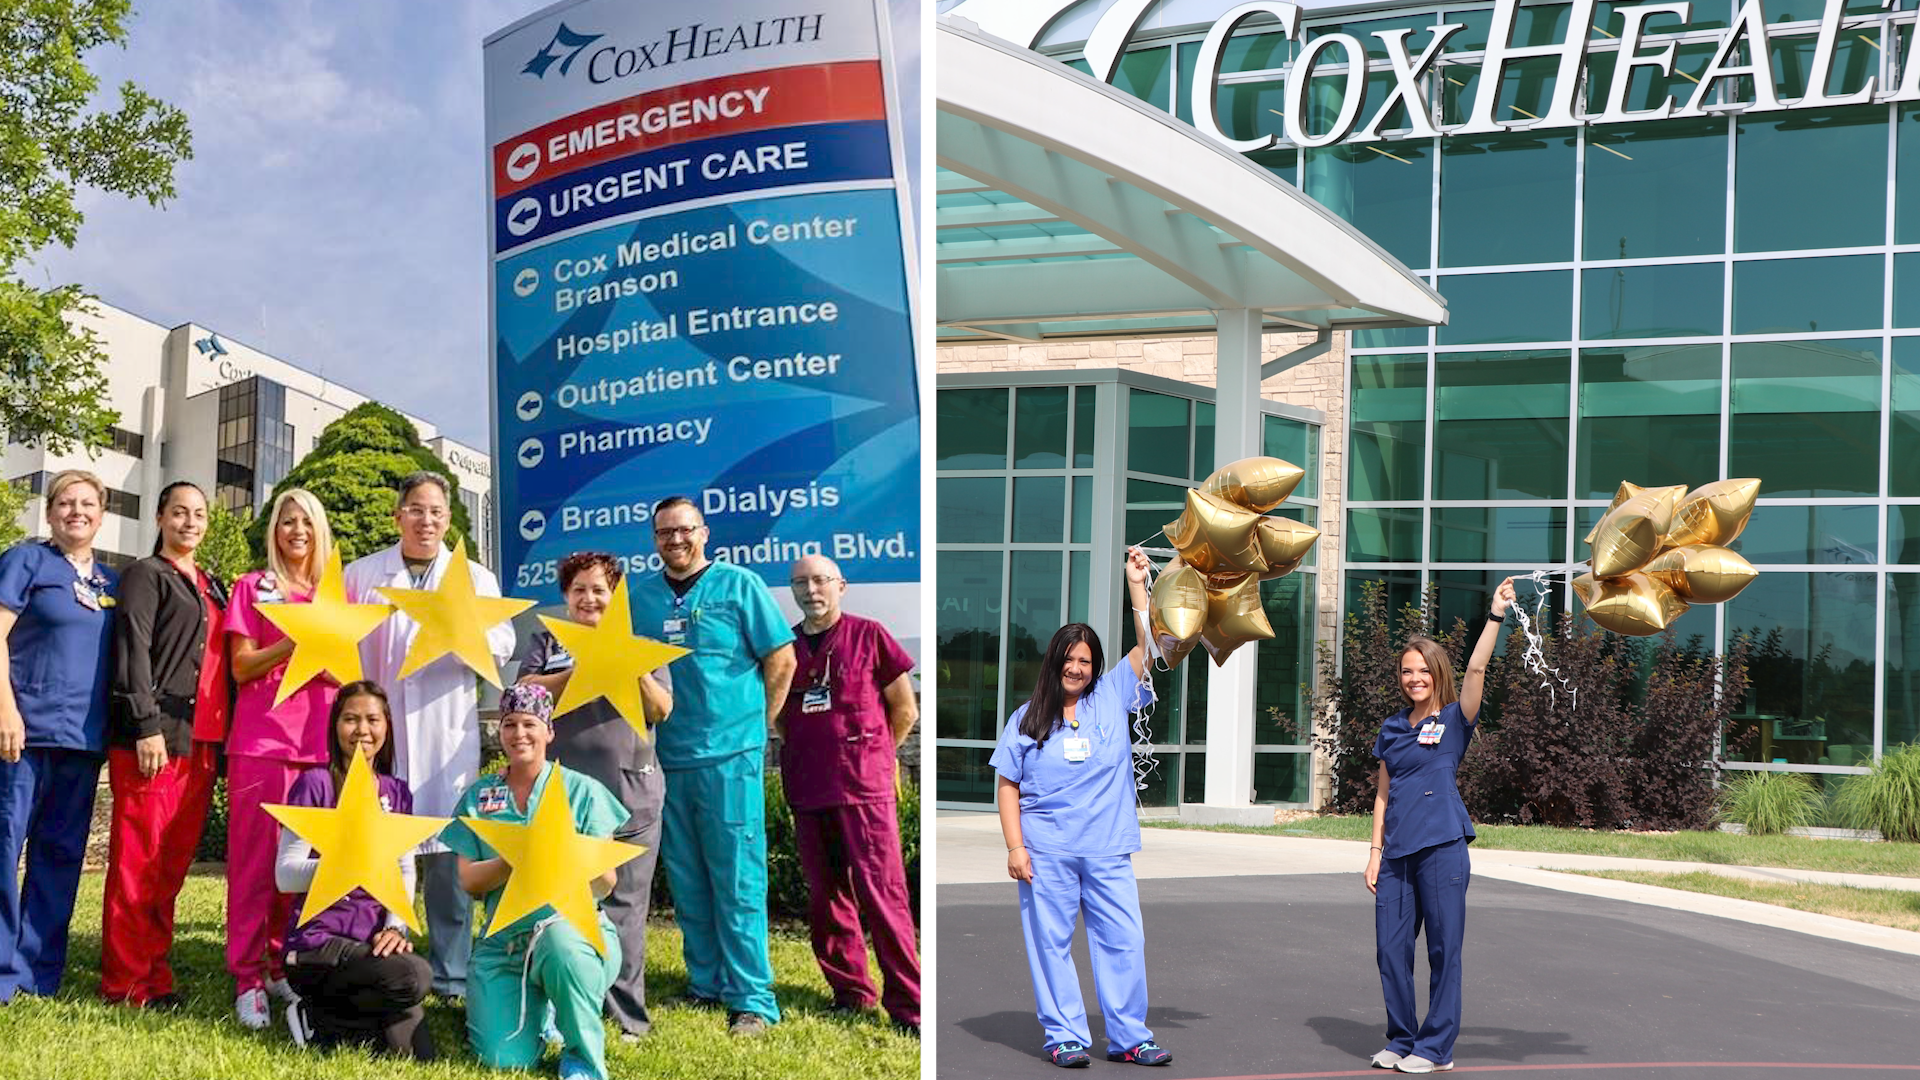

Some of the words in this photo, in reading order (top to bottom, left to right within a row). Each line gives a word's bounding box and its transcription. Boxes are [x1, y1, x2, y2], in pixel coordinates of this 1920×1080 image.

[547, 87, 770, 163] EMERGENCY
[548, 160, 690, 217] URGENT
[701, 142, 808, 181] CARE
[553, 251, 608, 283] Cox
[616, 225, 736, 267] Medical
[746, 216, 857, 243] Center
[555, 270, 679, 312] Branson
[556, 314, 678, 360] Hospital
[687, 302, 838, 335] Entrance
[557, 360, 717, 409] Outpatient
[727, 352, 841, 384] Center
[559, 418, 713, 459] Pharmacy
[704, 482, 840, 518] Dialysis
[517, 561, 557, 588] 525
[713, 537, 822, 565] anding
[833, 532, 915, 559] Blvd.
